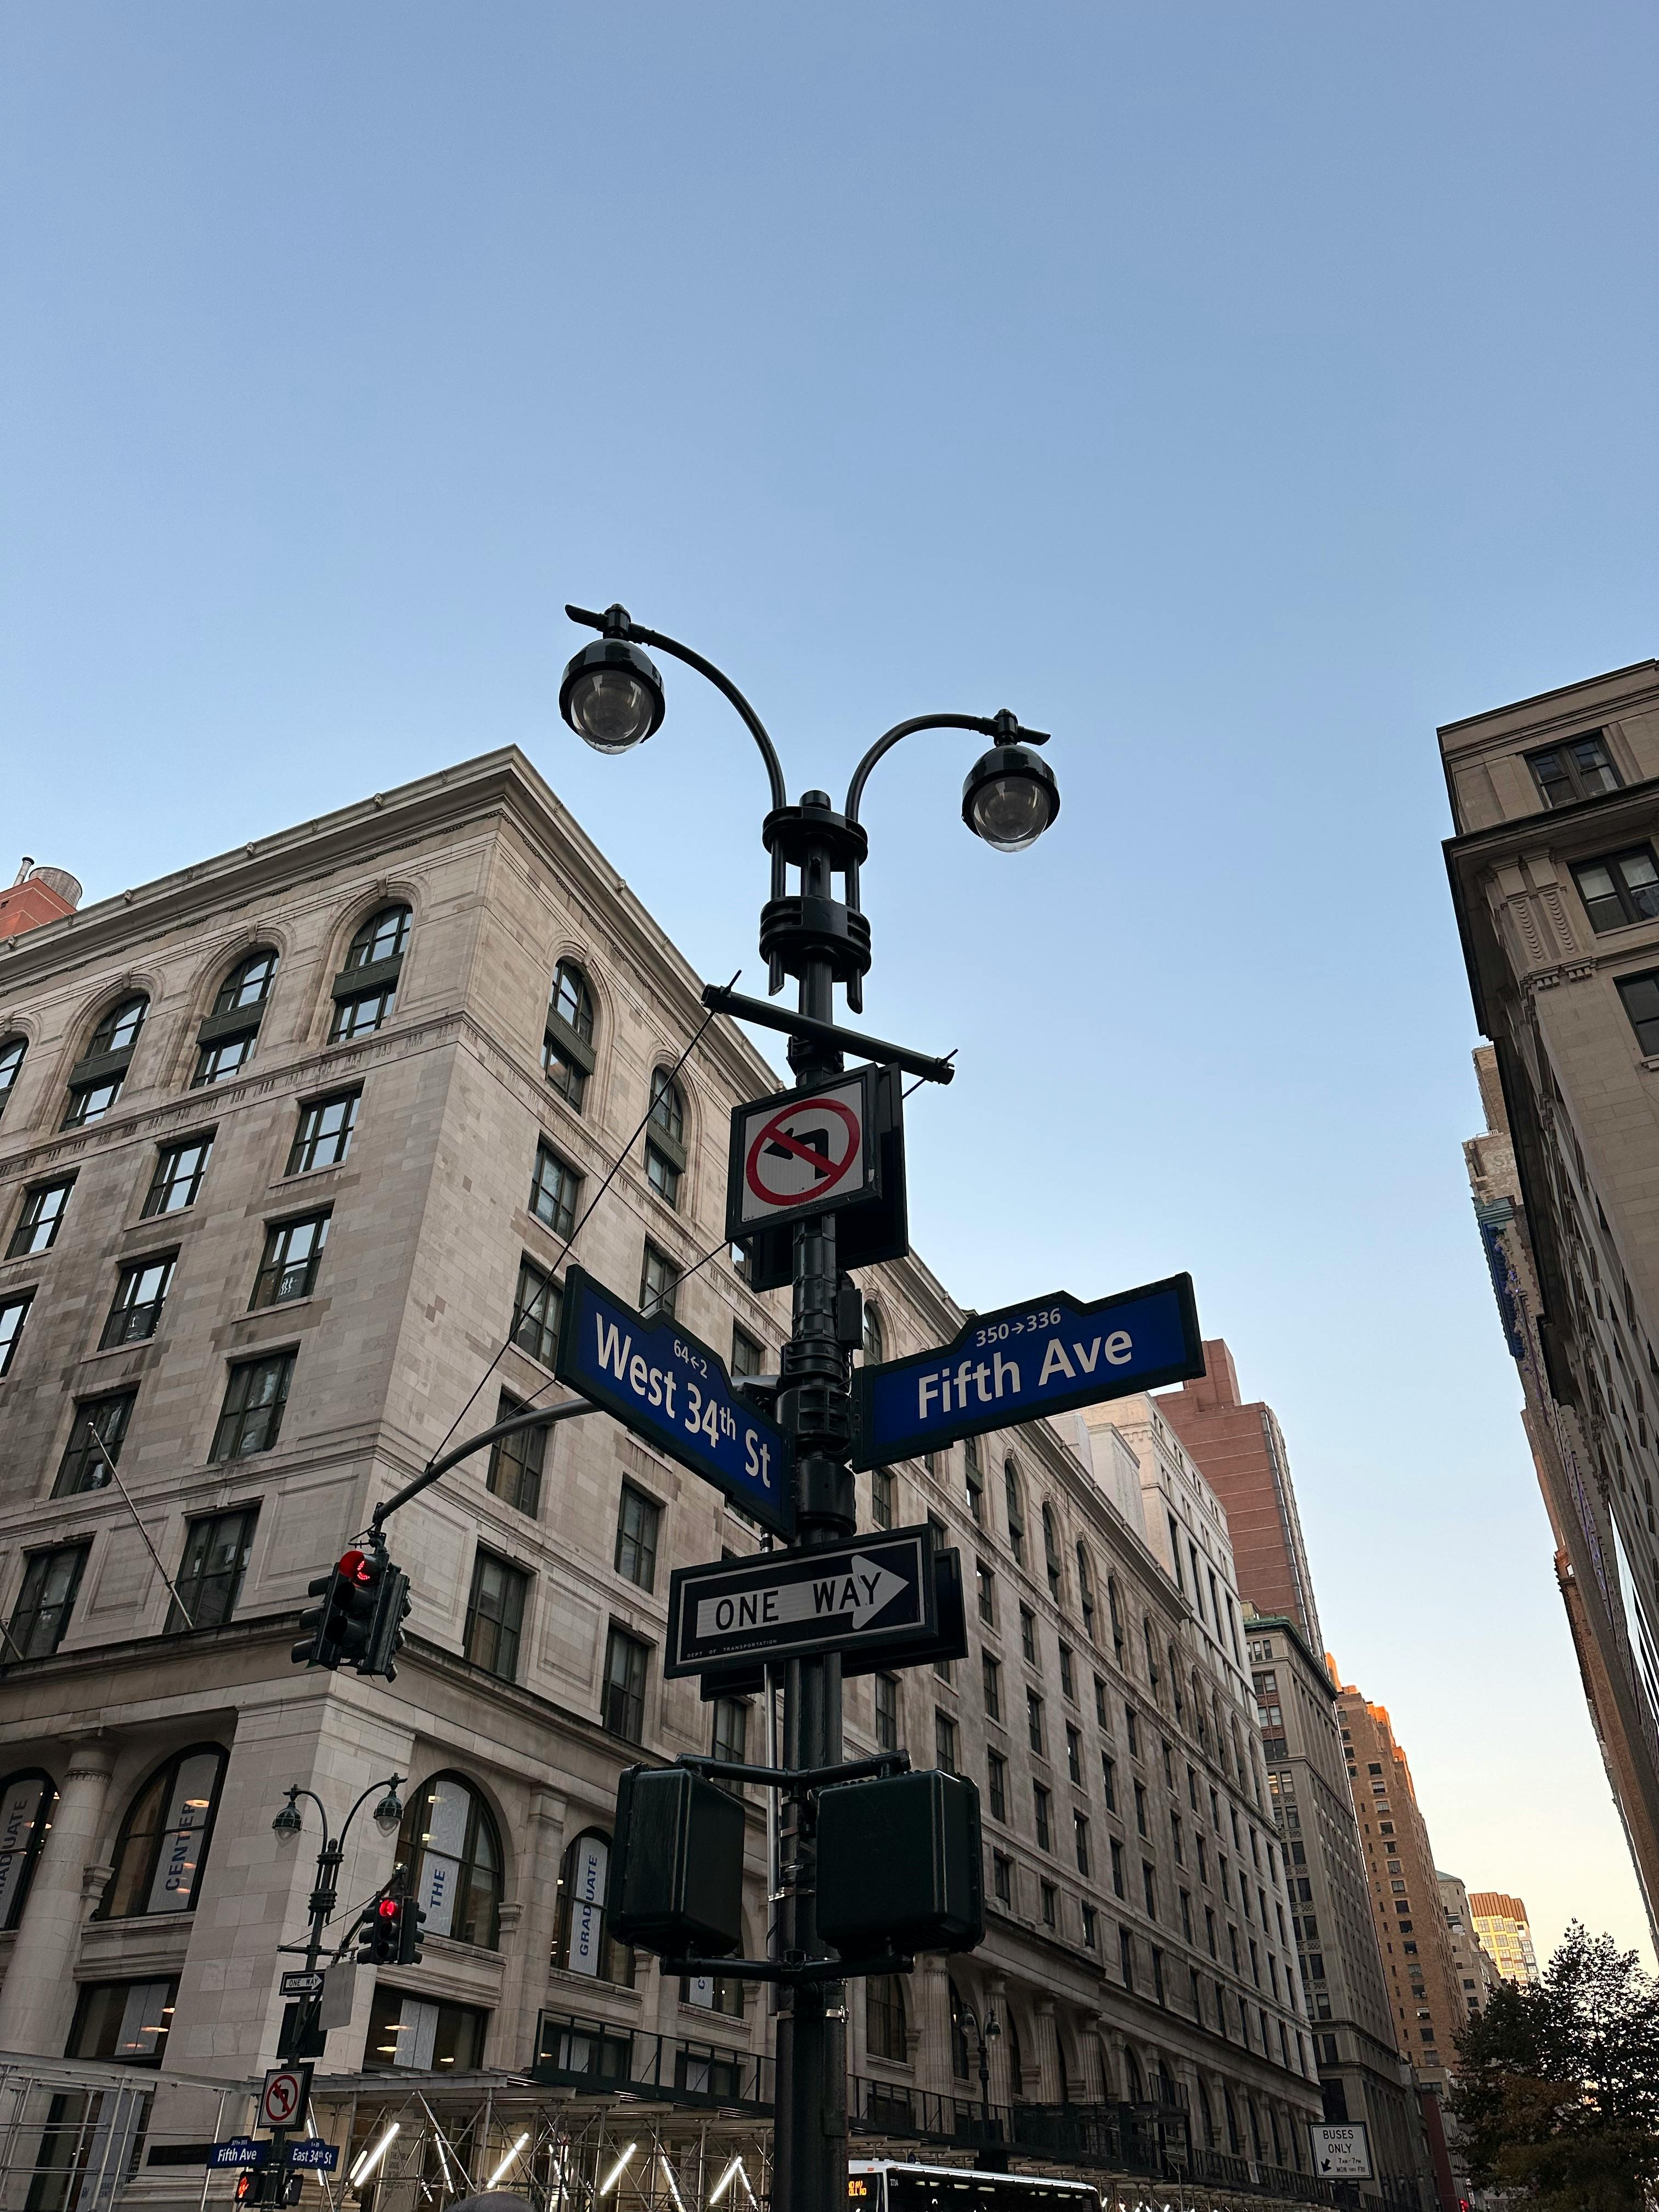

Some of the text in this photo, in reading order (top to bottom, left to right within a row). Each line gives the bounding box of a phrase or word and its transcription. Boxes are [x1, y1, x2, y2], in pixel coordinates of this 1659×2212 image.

[976, 1307, 1062, 1347] 350 336
[674, 1339, 708, 1379] 64 2
[918, 1329, 1133, 1420] Fifth Ave
[596, 1312, 771, 1488] West 34th St
[715, 1572, 882, 1631] ONE WAY
[723, 1639, 778, 1652] TRANSPORTATION
[430, 1868, 445, 1909] THE
[580, 1855, 597, 1956] GRADUATE
[289, 1977, 319, 1987] ONE WAY
[1323, 2129, 1354, 2140] BUSES
[1328, 2143, 1352, 2153] ONLY
[217, 2148, 257, 2162] Fifth Ave
[292, 2148, 332, 2165] East 34th St
